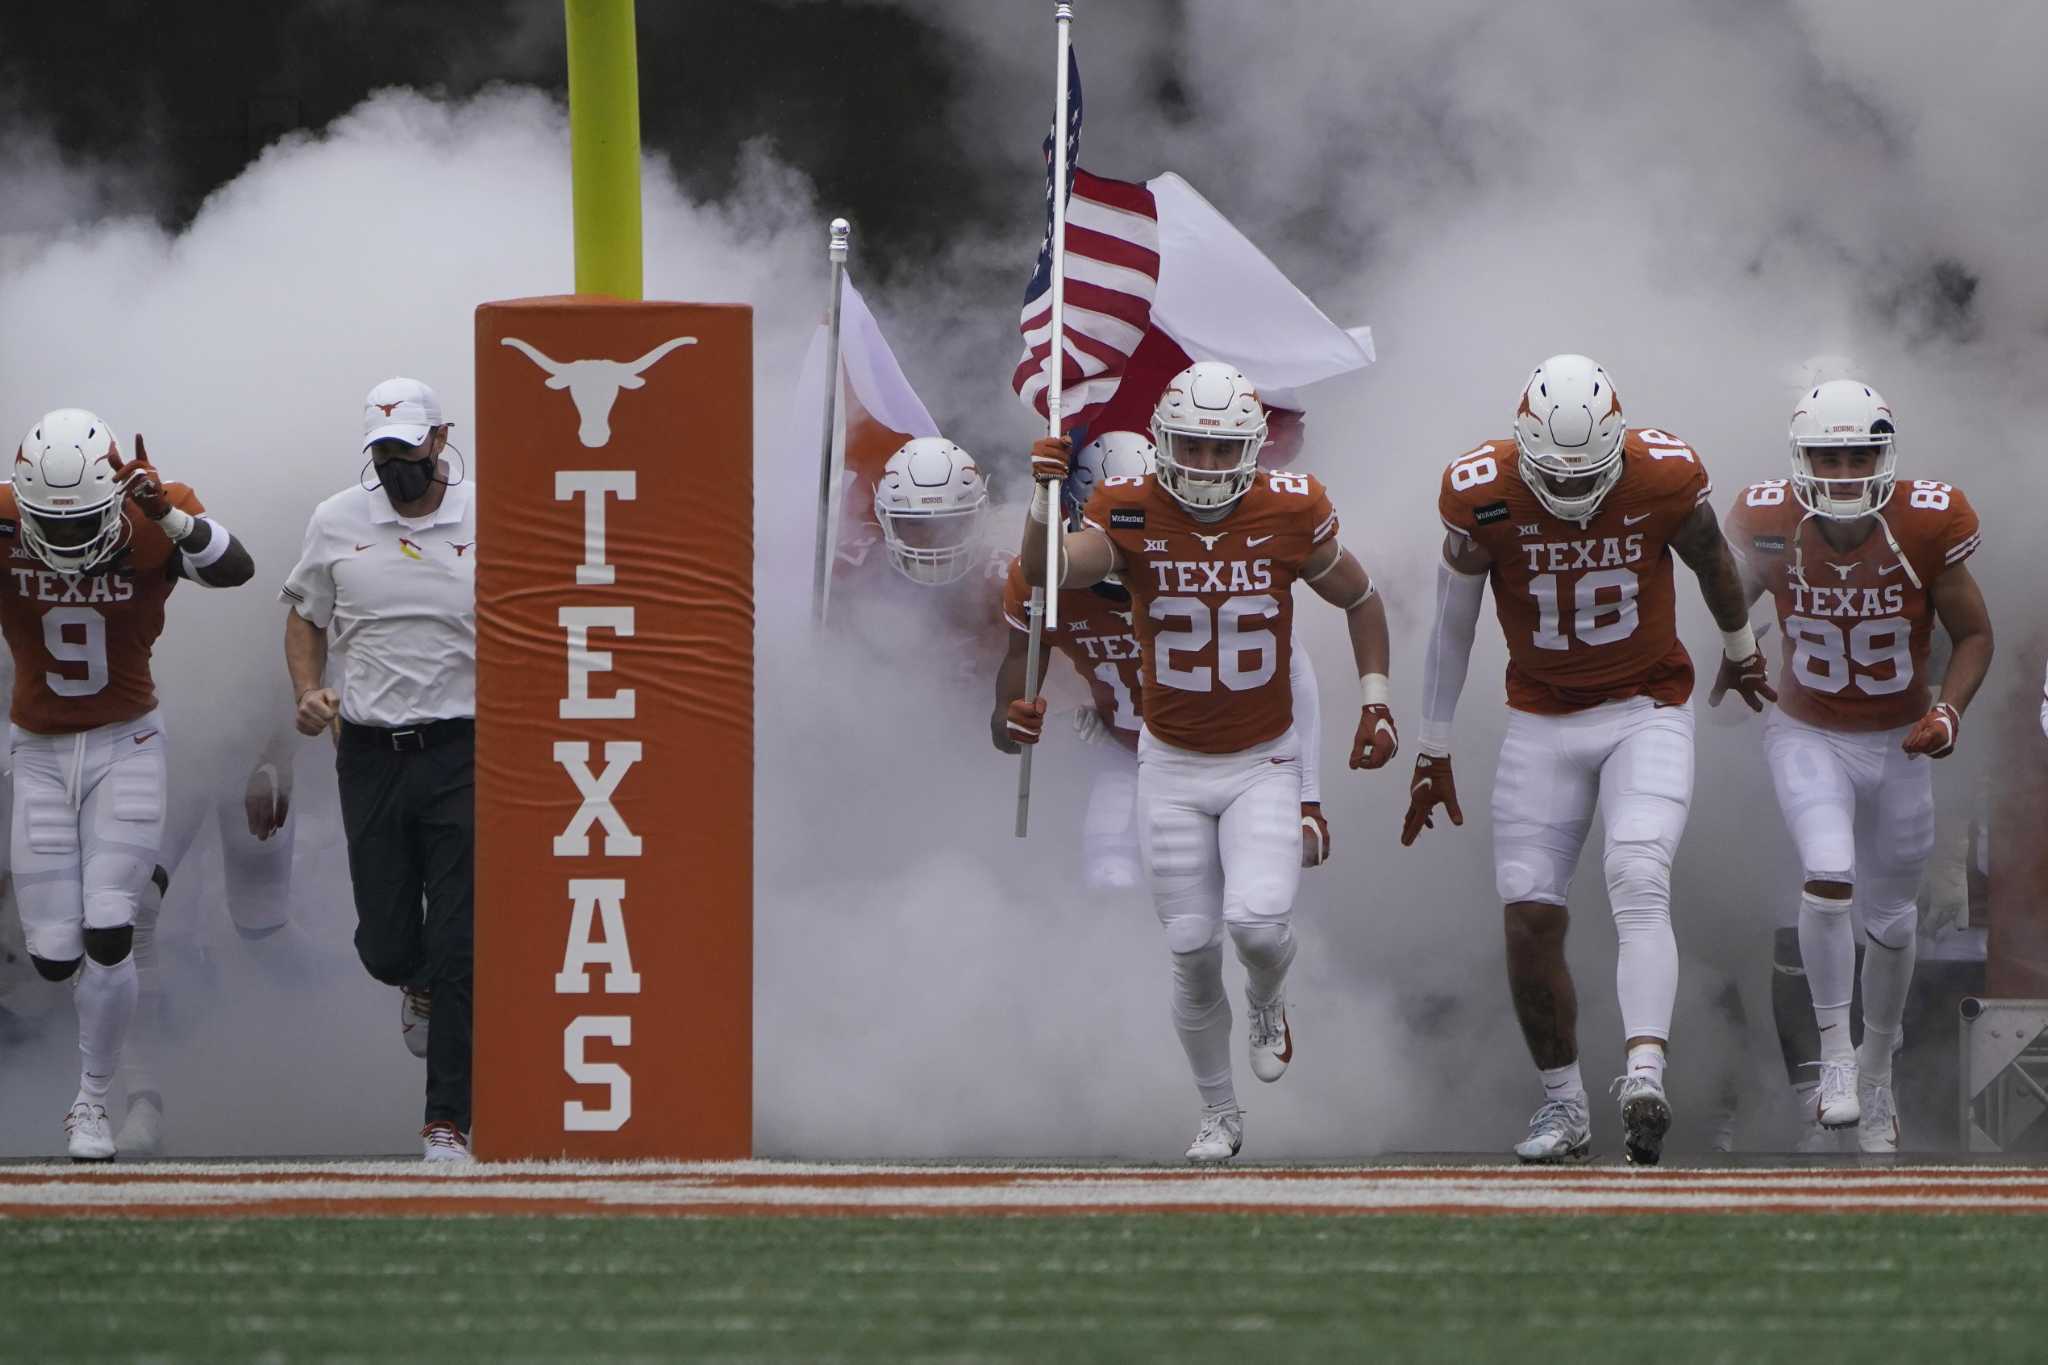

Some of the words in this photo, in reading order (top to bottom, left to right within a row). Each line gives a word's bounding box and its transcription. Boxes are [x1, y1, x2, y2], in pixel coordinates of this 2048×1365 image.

[1143, 538, 1169, 552] XII
[1522, 533, 1644, 572] TEXAS
[11, 567, 134, 603] TEXAS
[1150, 558, 1272, 593] TEXAS
[1788, 583, 1904, 617] TEXAS
[1529, 567, 1640, 651] 18
[41, 606, 108, 697] 9
[1076, 634, 1142, 660] TEX
[1148, 594, 1280, 693] 26
[1785, 614, 1914, 696] 89
[1094, 662, 1144, 732] 1
[554, 470, 642, 1132] TEXAS
